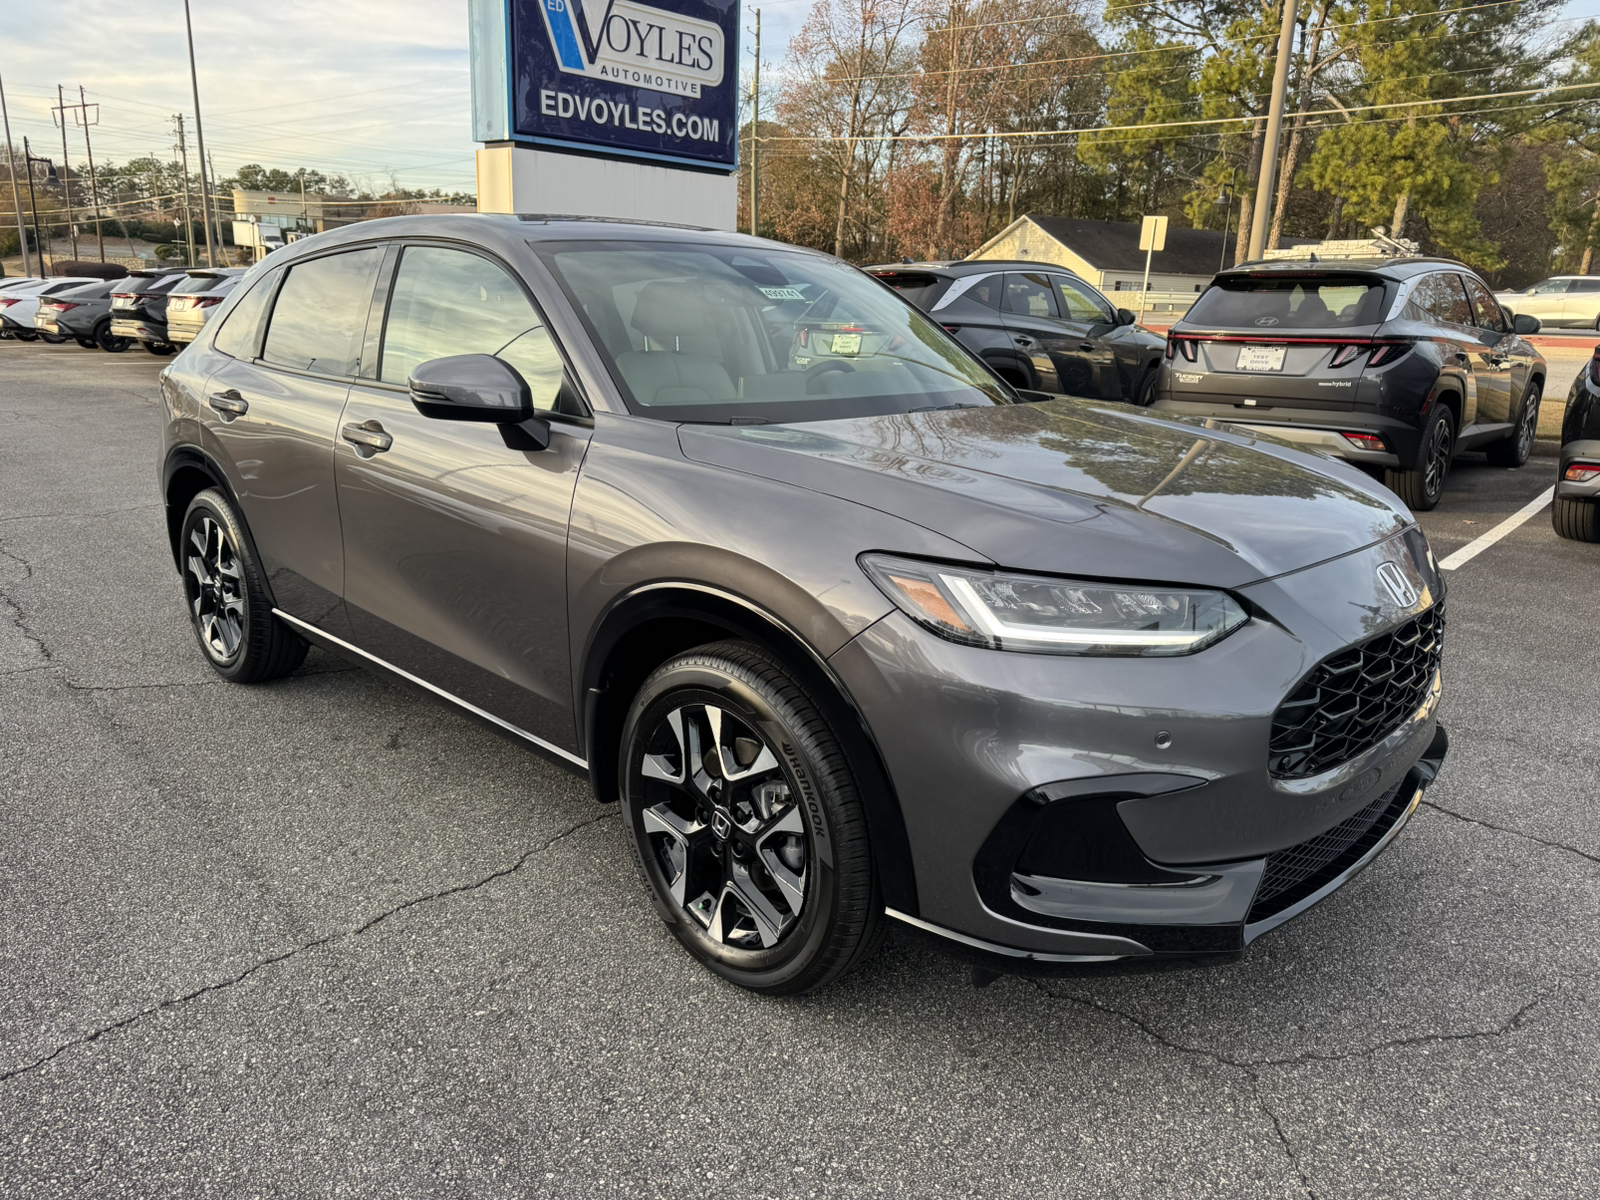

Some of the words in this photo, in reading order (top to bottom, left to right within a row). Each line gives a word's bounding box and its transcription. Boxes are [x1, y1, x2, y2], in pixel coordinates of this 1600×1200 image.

[547, 0, 564, 12] ED
[569, 0, 712, 71] VOYLES
[600, 65, 698, 94] AUTOMOTIVE
[540, 89, 719, 142] EDVOYLES.COM
